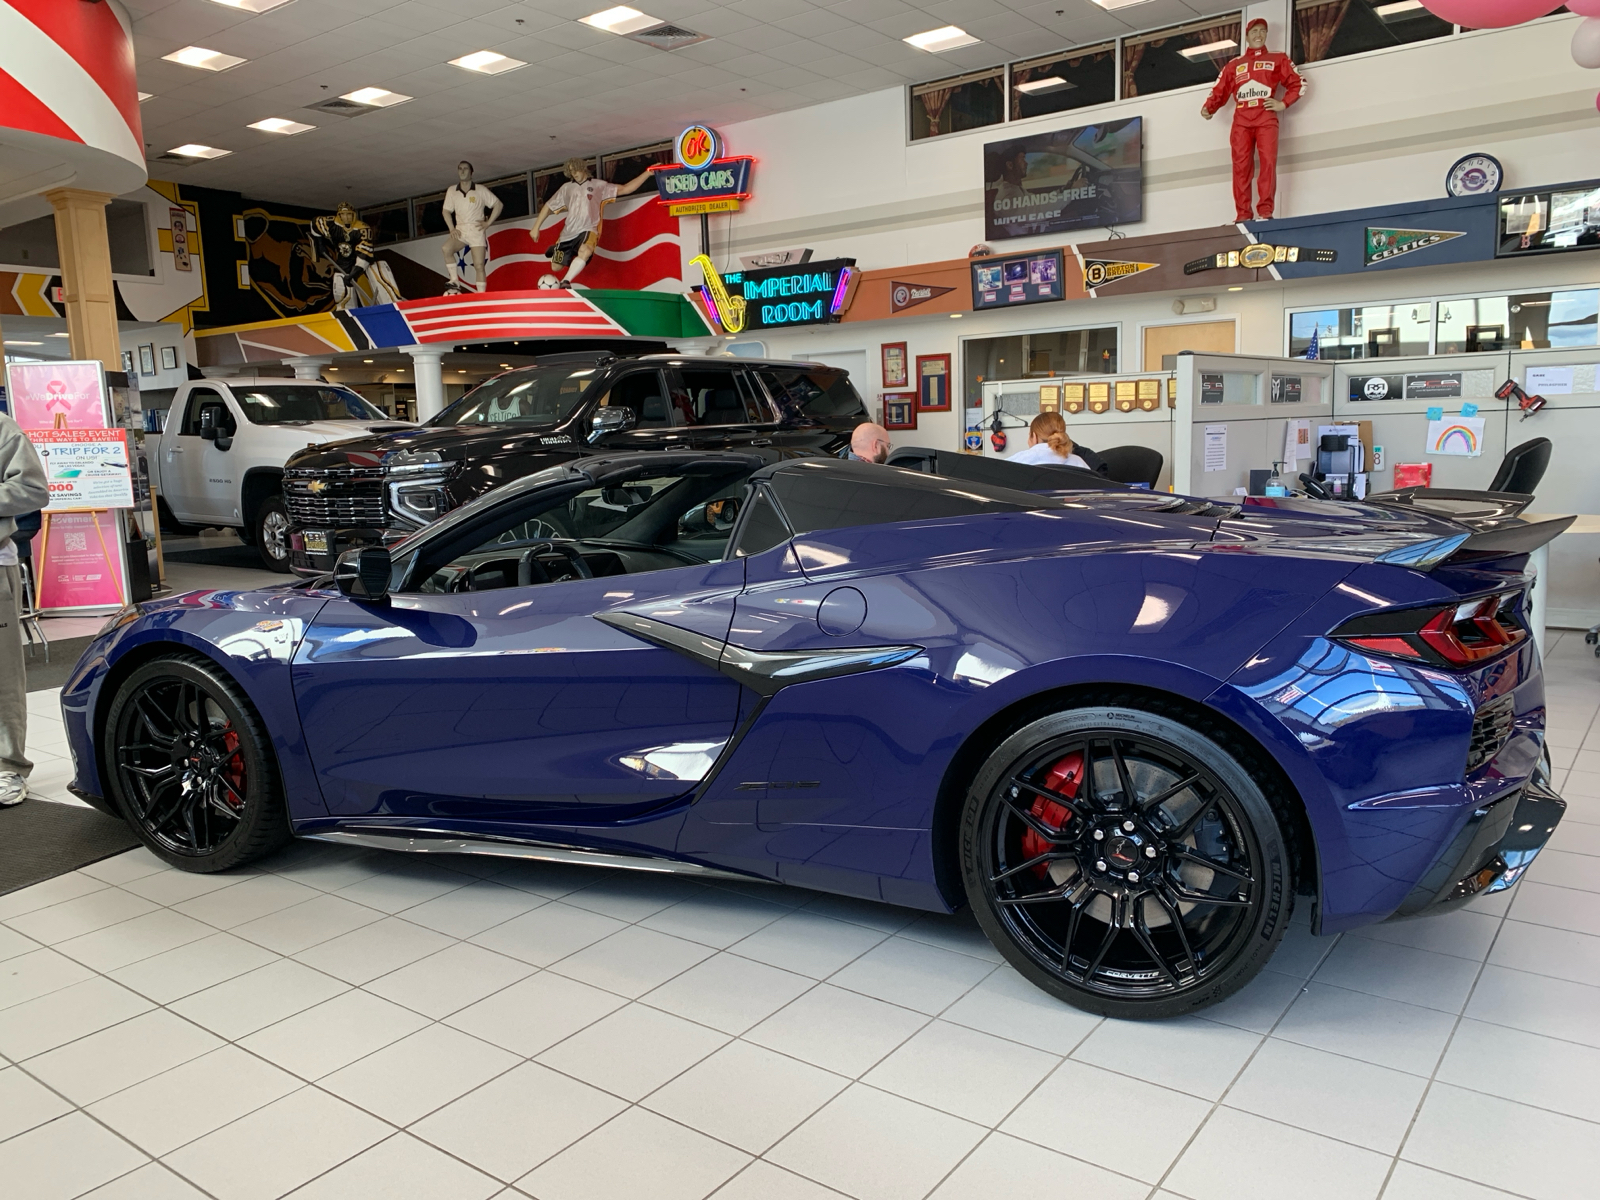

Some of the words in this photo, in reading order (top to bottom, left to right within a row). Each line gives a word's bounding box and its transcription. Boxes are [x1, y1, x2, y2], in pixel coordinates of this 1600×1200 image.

[1238, 87, 1268, 99] Marlboro
[686, 129, 710, 159] OK
[665, 173, 698, 194] USED
[700, 168, 735, 190] CARS
[993, 198, 1011, 212] GO
[1012, 185, 1097, 209] HANDS-FREE
[675, 204, 706, 214] AUTHORIZED
[708, 201, 728, 210] DEALER
[1371, 234, 1440, 261] CELTICS
[1107, 263, 1136, 271] BOSTON
[1107, 269, 1135, 277] BRUINS
[724, 272, 742, 284] THE
[1092, 267, 1101, 281] B
[743, 271, 834, 300] IMPERIAL
[761, 299, 823, 324] ROOM
[52, 430, 87, 438] SALES
[88, 429, 121, 437] EVENT
[52, 447, 81, 456] TRIP
[83, 446, 110, 455] FOR
[112, 446, 121, 454] 2
[1262, 861, 1282, 938] MICHELIN
[1105, 969, 1160, 979] CORVETTE
